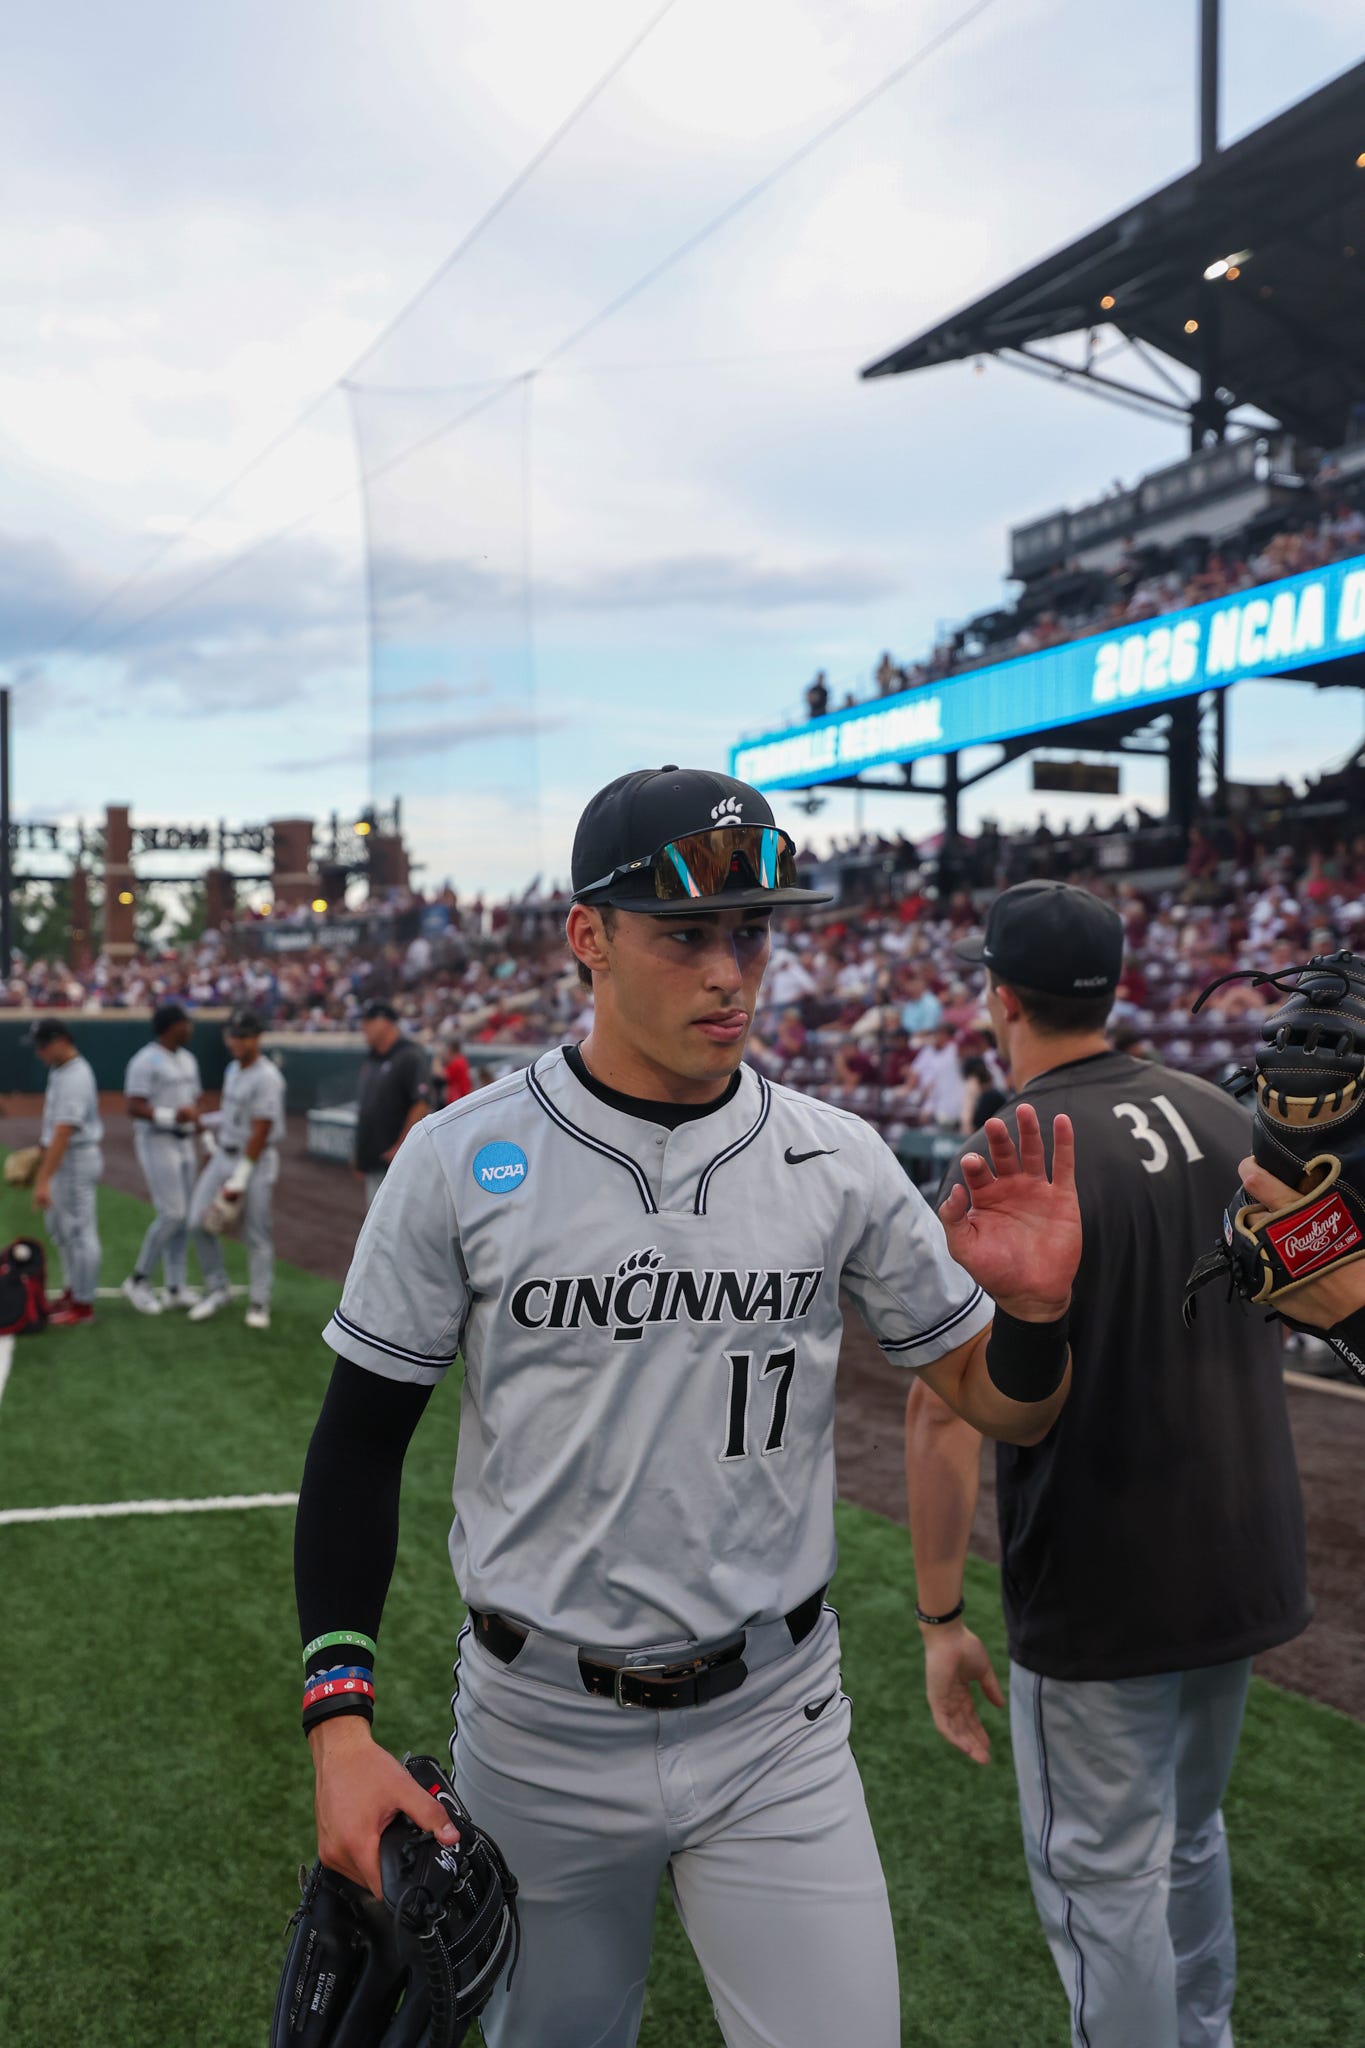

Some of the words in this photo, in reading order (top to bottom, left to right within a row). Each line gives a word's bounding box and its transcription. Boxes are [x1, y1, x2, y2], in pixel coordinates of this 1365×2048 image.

[1091, 619, 1201, 704] 2026
[1206, 583, 1326, 675] NCAA
[481, 1163, 525, 1181] NCAA
[1112, 1094, 1205, 1174] 31
[1285, 1211, 1342, 1258] Rawlings
[509, 1256, 825, 1338] CINCINNATI
[718, 1343, 797, 1463] 17
